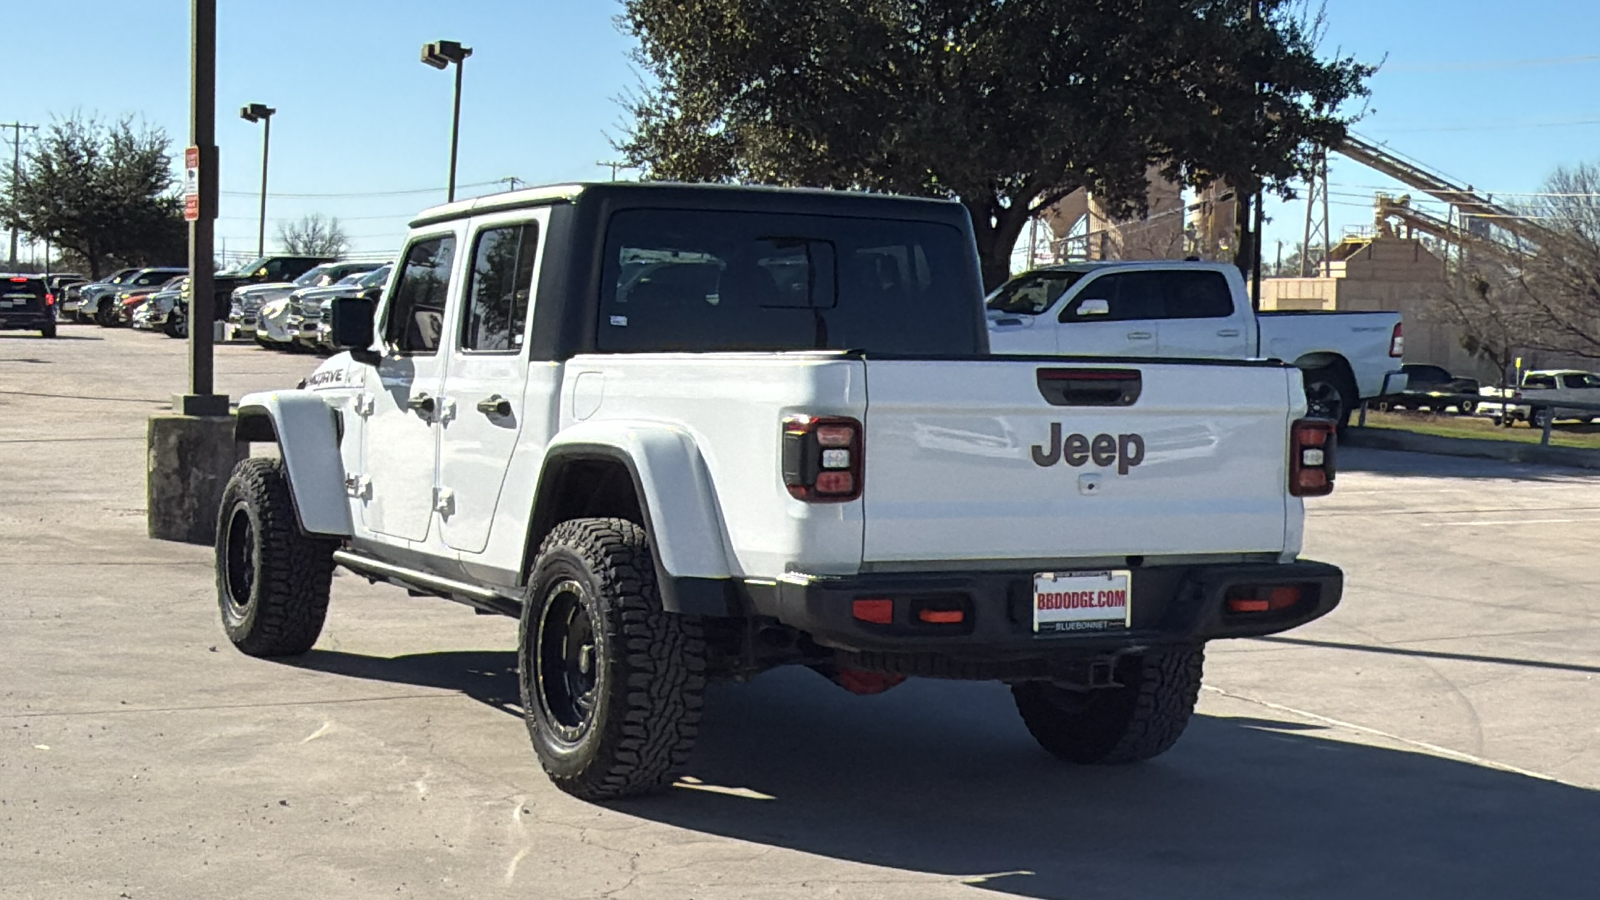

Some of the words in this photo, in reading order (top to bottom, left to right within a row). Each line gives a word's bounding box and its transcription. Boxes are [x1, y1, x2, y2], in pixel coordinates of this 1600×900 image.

[1031, 422, 1145, 475] Jeep
[1037, 590, 1126, 610] BBDODGE.COM
[1055, 621, 1108, 631] BLUEBONNET
